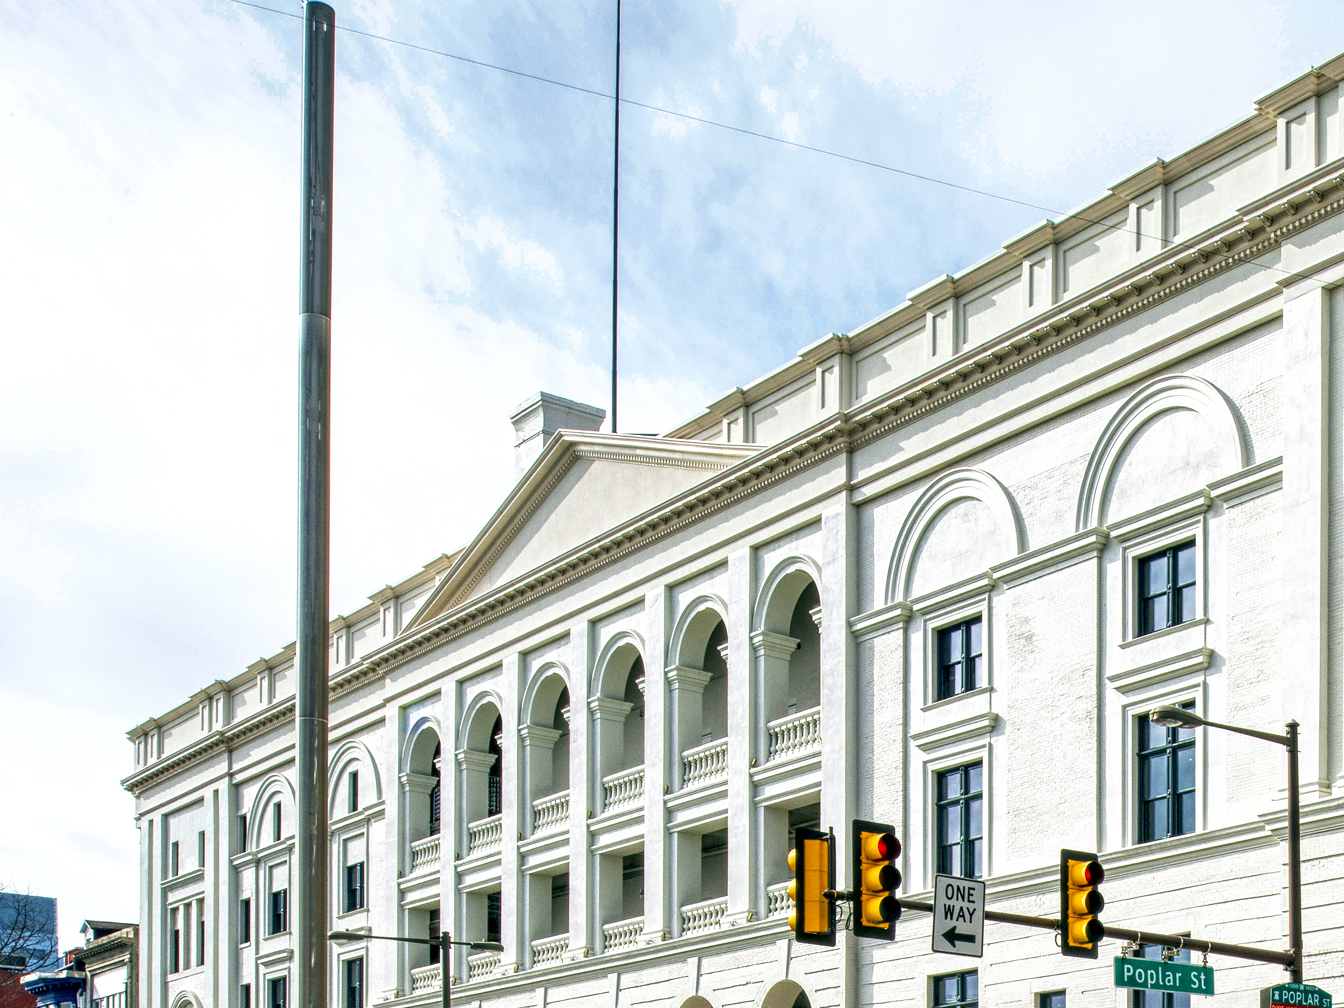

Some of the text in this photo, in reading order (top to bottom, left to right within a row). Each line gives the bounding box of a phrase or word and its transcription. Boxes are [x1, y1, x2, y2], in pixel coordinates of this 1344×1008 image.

[945, 883, 976, 904] ONE
[943, 903, 977, 924] WAY
[1124, 964, 1206, 990] Poplar St
[1282, 990, 1330, 1007] POPLAR ST
